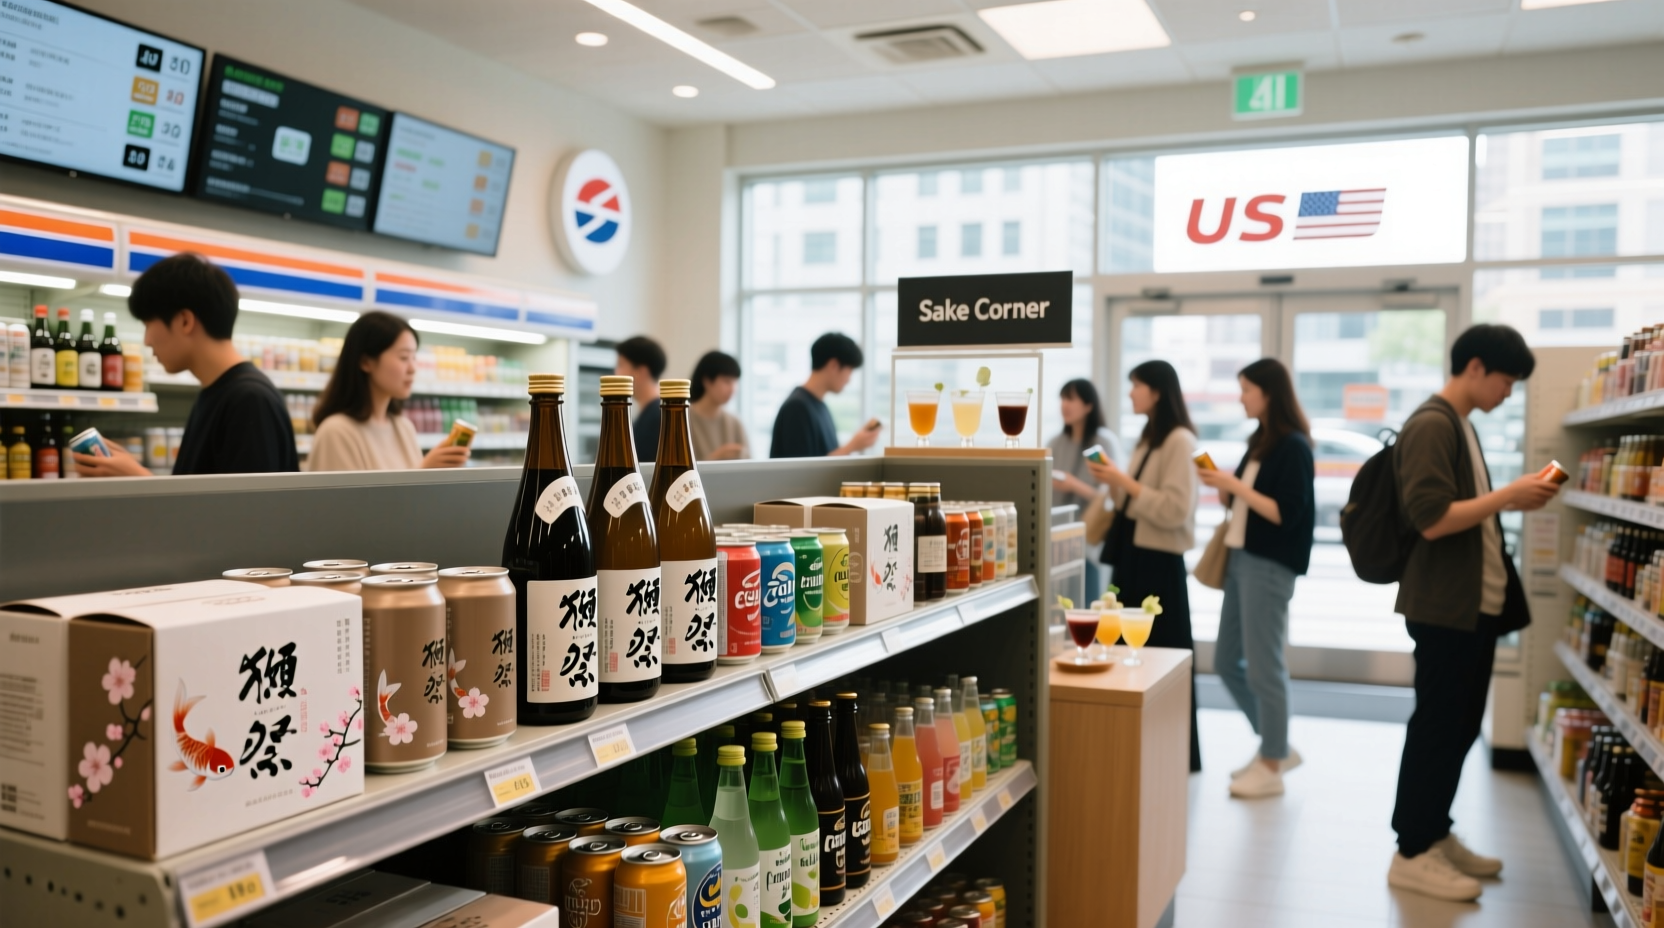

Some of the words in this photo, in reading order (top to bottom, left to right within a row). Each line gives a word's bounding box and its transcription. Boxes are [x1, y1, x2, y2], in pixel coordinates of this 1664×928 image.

[1186, 193, 1287, 245] US
[918, 298, 970, 323] Sake
[974, 297, 1051, 321] Corner
